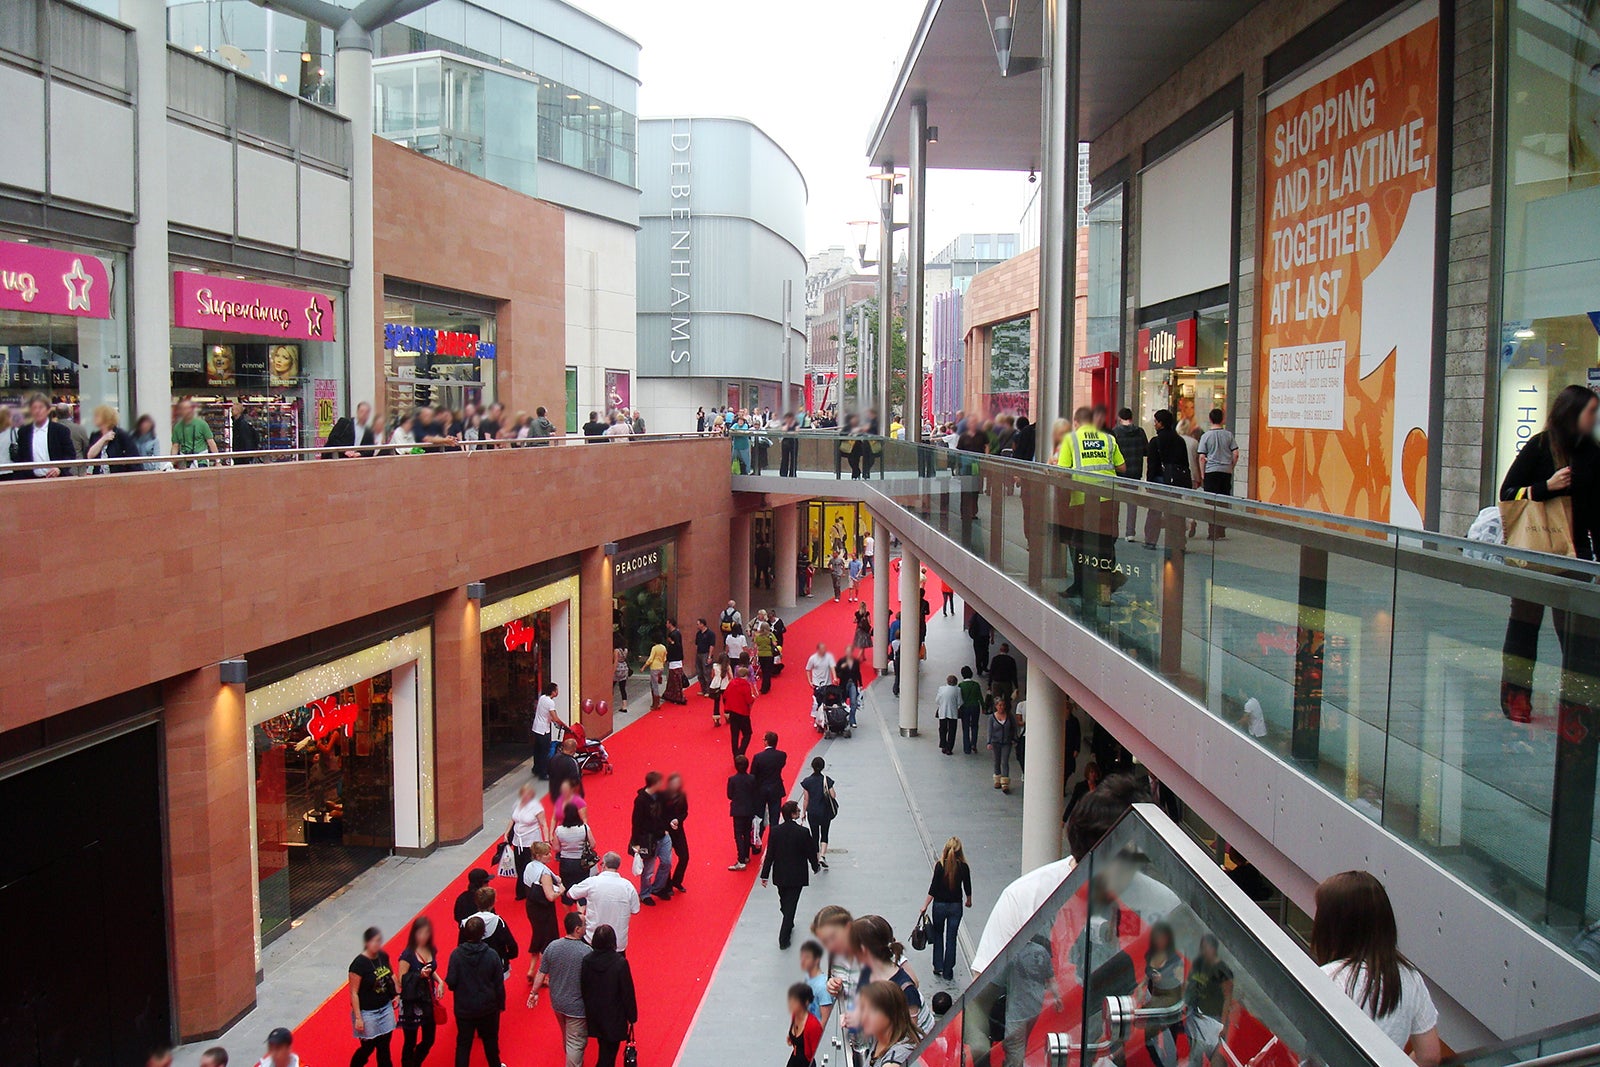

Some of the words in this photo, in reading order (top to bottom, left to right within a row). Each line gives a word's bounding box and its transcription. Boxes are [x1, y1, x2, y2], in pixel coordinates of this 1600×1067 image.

[1274, 78, 1376, 167] SHOPPING
[1272, 167, 1310, 221] AND
[1316, 117, 1430, 205] PLAYTIME,
[670, 132, 691, 364] DEBENHAMS
[1272, 202, 1371, 273] TOGETHER
[0, 270, 39, 303] ug
[197, 288, 291, 330] Superdrug
[1270, 281, 1291, 326] AT
[1295, 269, 1342, 321] LAST
[1316, 349, 1326, 370] TO
[1328, 348, 1342, 369] LET
[1518, 385, 1538, 393] 1
[615, 552, 658, 576] PEACOCKS
